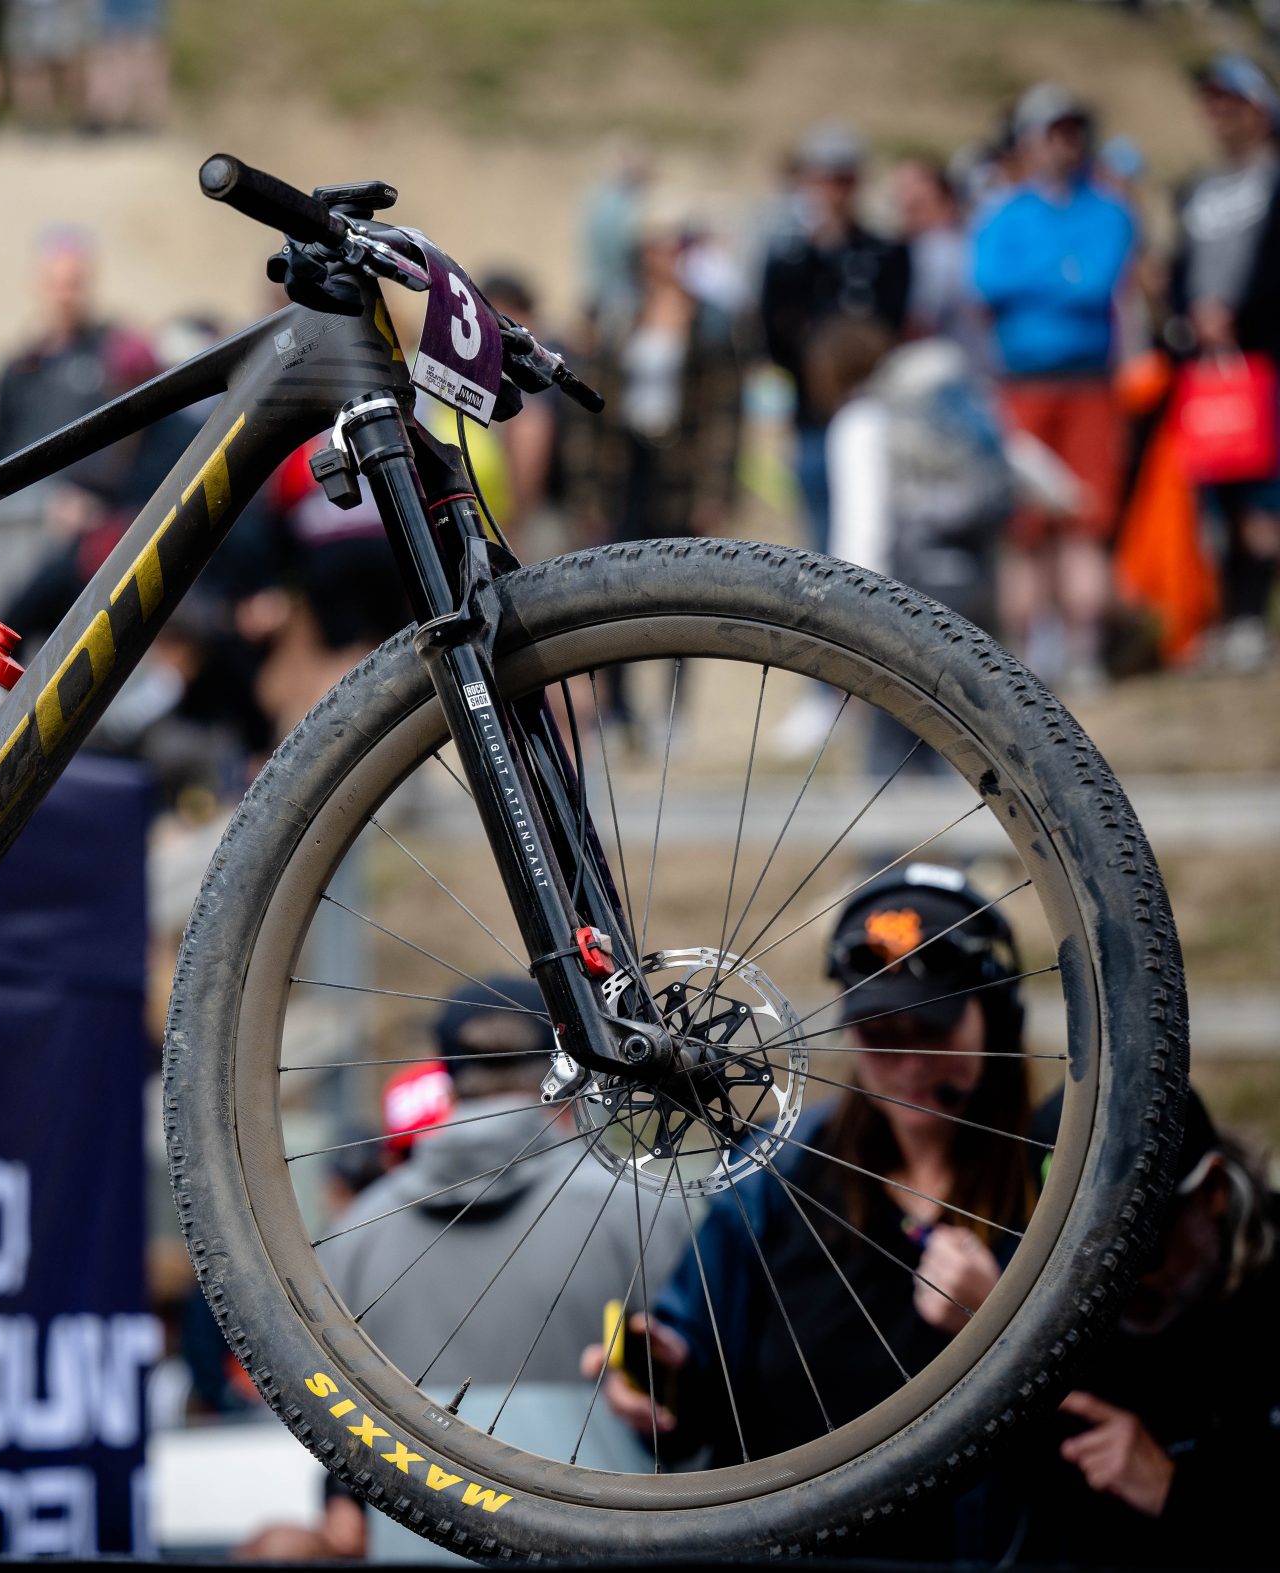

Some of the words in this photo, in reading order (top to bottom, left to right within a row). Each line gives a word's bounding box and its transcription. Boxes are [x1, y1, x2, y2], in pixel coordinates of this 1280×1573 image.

[448, 272, 483, 361] 3
[465, 683, 486, 697] ROCK
[480, 713, 508, 775] FLIGHT
[505, 787, 549, 888] ATTENDANT
[305, 1372, 514, 1513] MAXXIS
